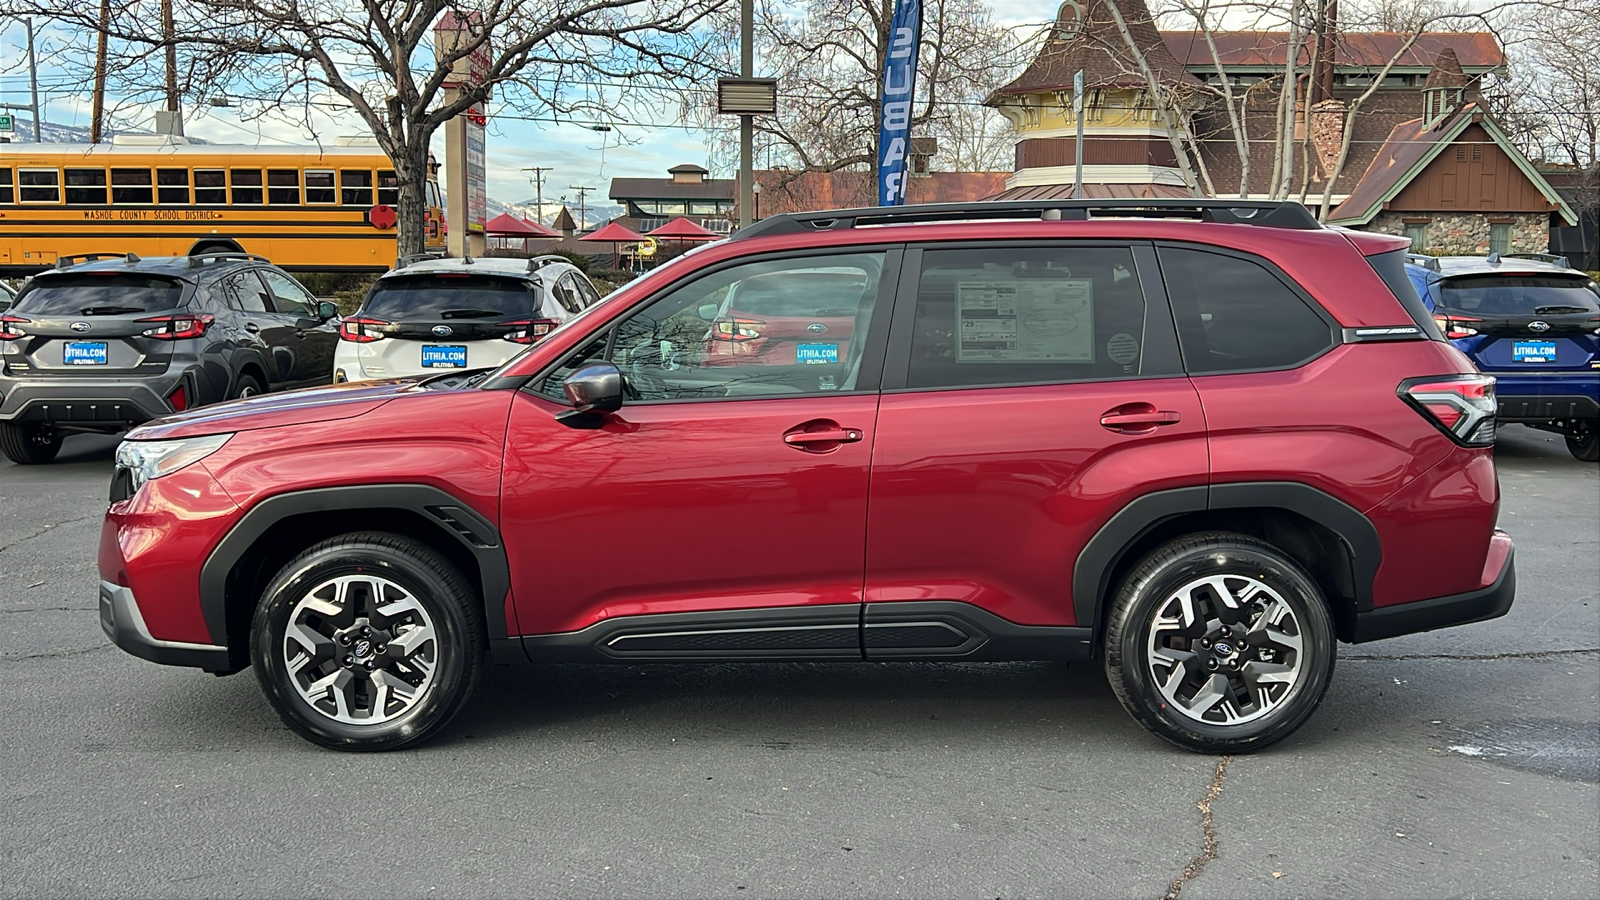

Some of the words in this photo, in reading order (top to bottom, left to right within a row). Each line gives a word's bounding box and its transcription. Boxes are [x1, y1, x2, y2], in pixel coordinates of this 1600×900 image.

[84, 211, 113, 220] WASHOE
[119, 211, 147, 220] COUNTY
[154, 211, 180, 220] SCHOOL
[185, 211, 214, 220] DISTRICT
[65, 348, 106, 357] LITHIA.COM
[423, 351, 465, 361] LITHIA.COM
[797, 349, 837, 358] LITHIA.COM
[1514, 347, 1556, 356] LITHIA.COM
